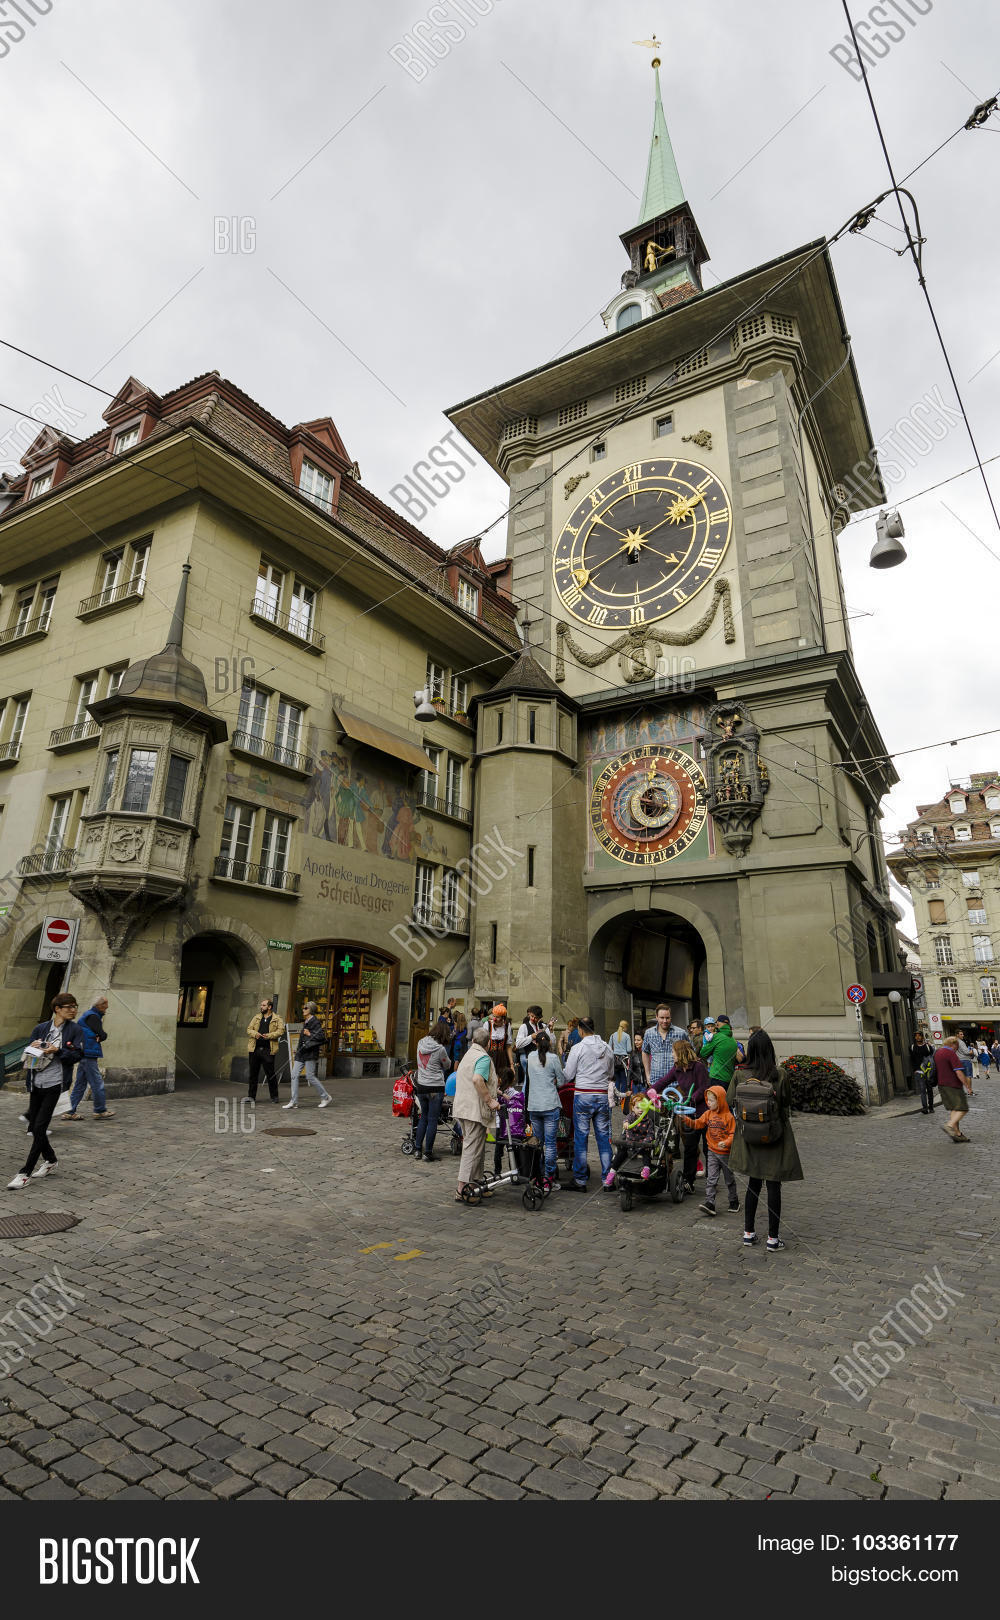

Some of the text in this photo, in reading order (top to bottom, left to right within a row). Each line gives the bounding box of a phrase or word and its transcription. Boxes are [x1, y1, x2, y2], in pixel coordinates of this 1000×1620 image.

[303, 857, 410, 896] Apotheke und Drogerie
[317, 880, 394, 913] Scheidegger
